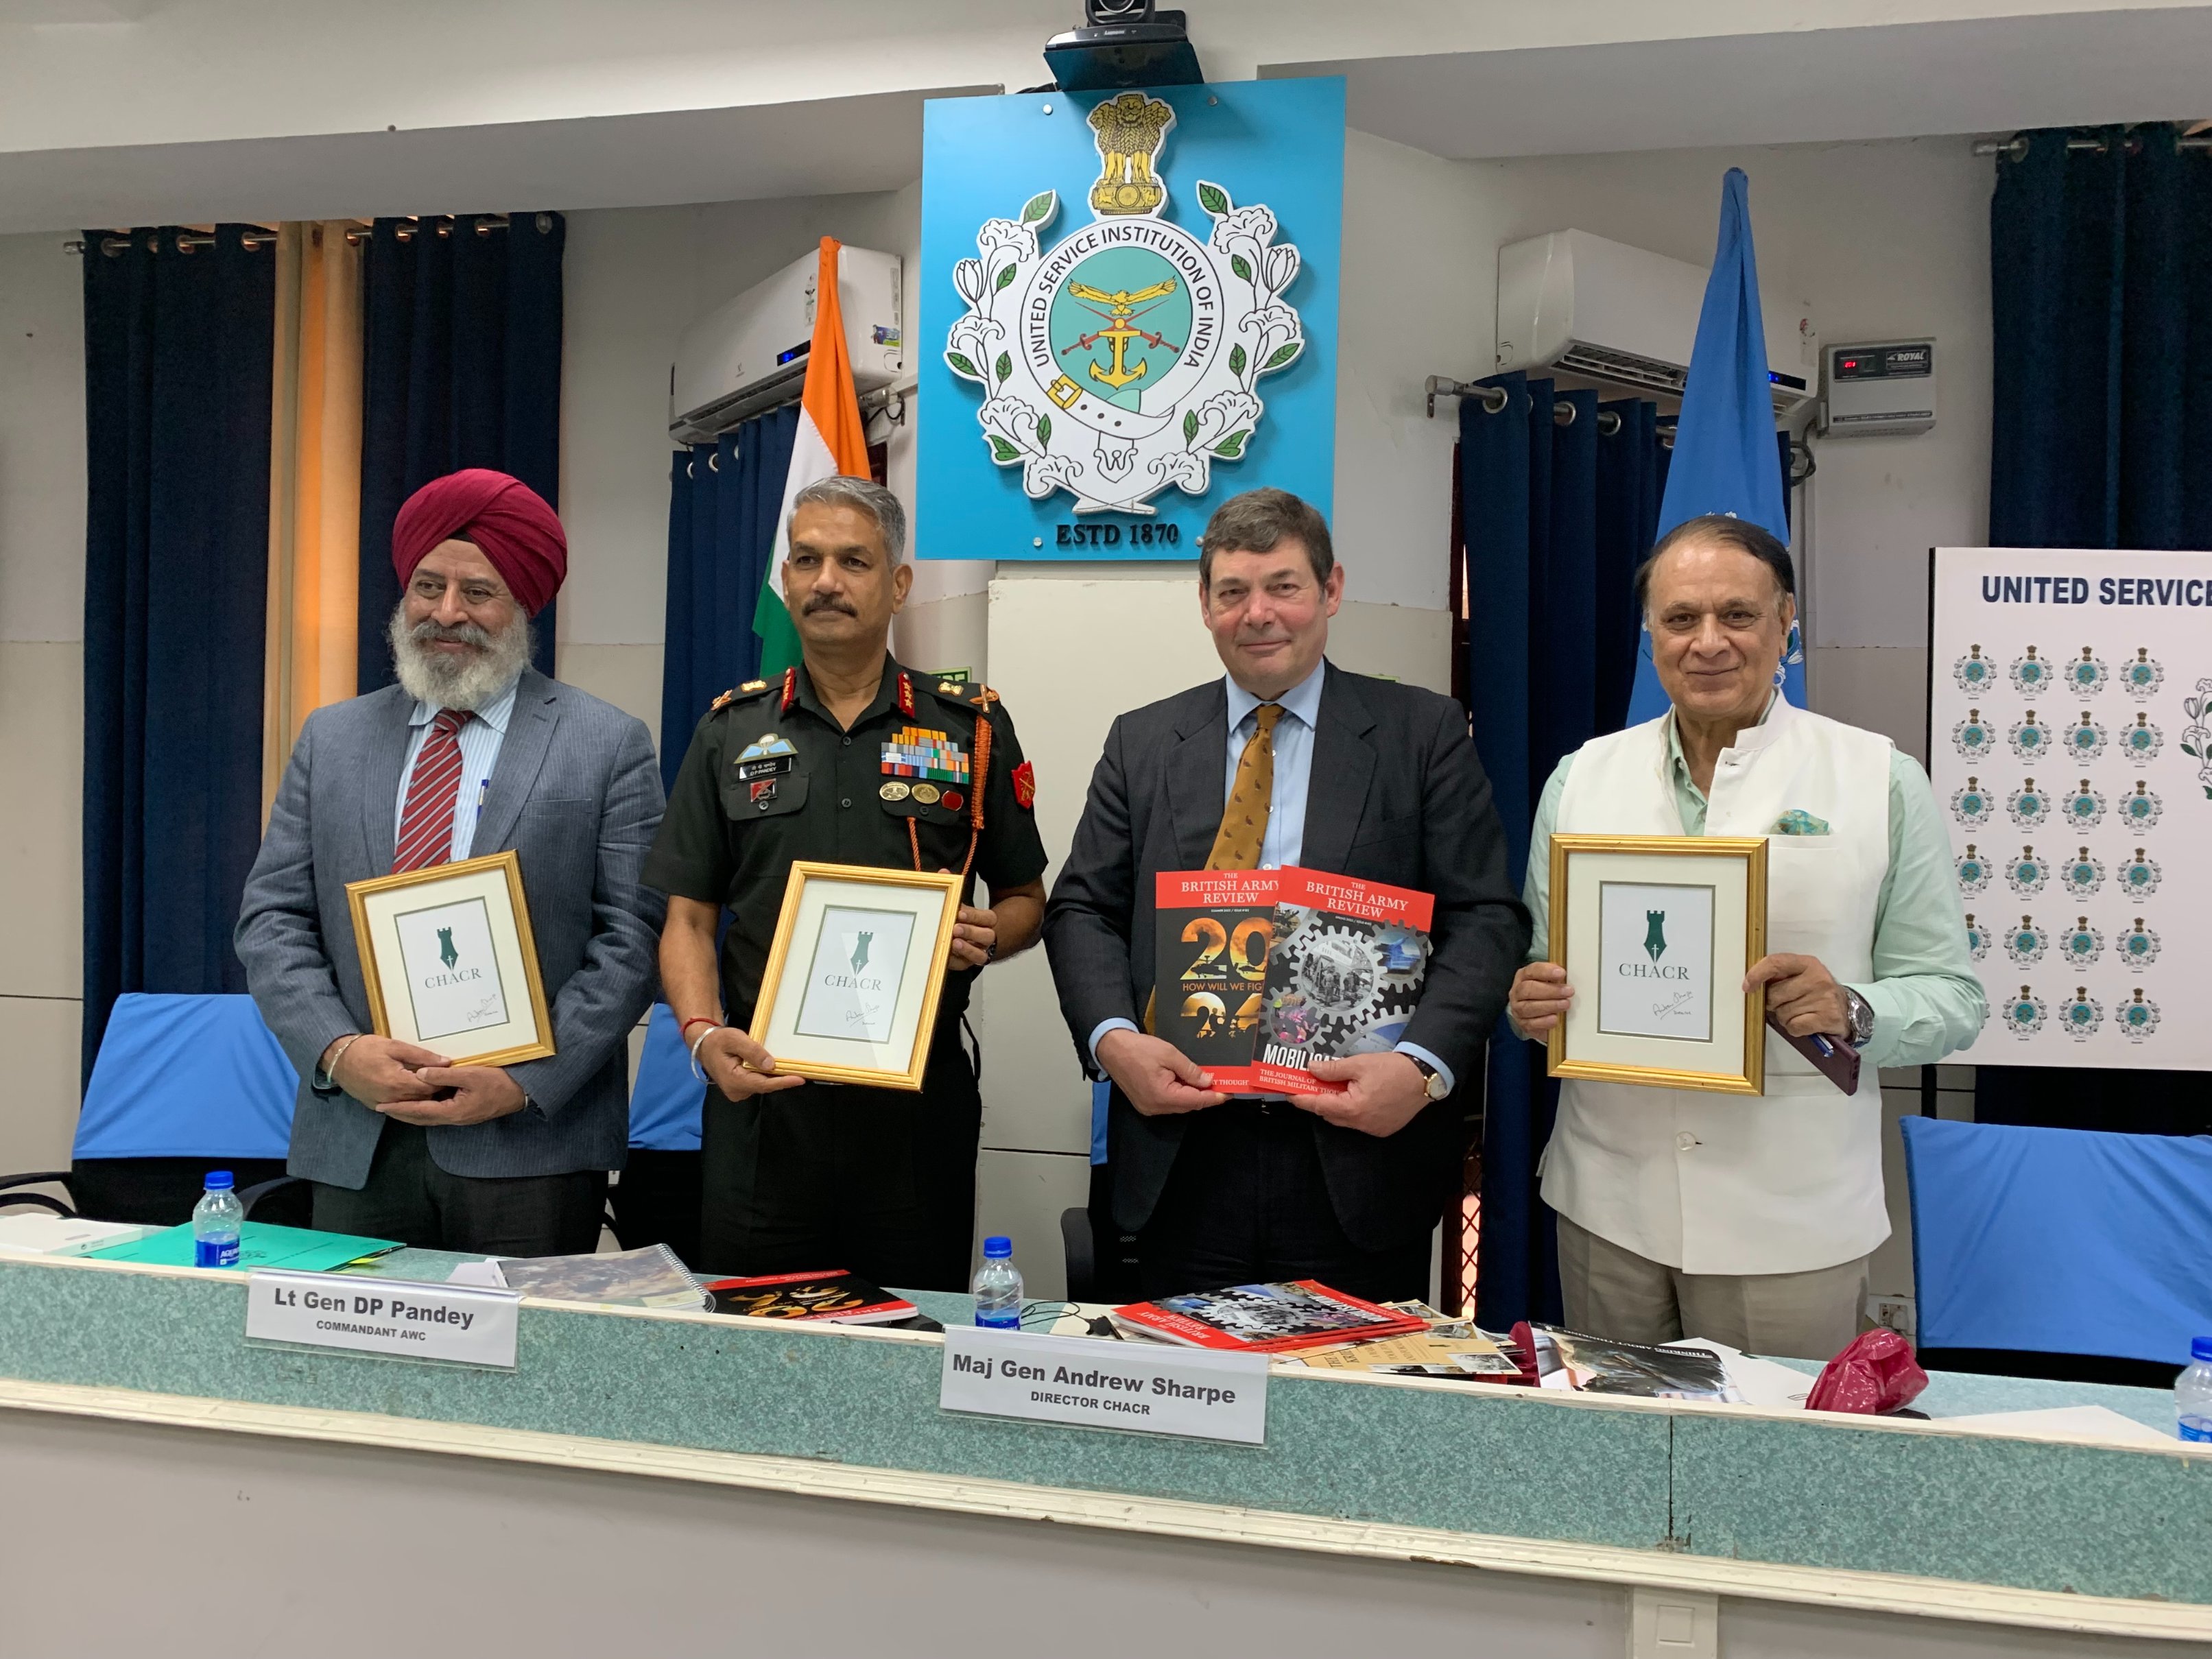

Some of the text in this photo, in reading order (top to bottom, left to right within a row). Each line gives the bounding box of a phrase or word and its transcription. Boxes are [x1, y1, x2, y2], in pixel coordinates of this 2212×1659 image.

[1030, 226, 1213, 368] UNITED SERVICE INSTITUTION OF INDIA
[1056, 523, 1178, 544] ESTD 1870
[1982, 575, 2089, 604] UNITED
[1181, 881, 1237, 892] BRITISH
[1306, 881, 1409, 911] BRITISH ARMY
[1351, 882, 1366, 890] THE
[1203, 893, 1259, 903] REVIEW
[1327, 898, 1384, 918] REVIEW
[425, 968, 481, 988] CHACR
[1619, 963, 1690, 980] CHACR
[824, 975, 881, 990] CHACR
[1182, 982, 1262, 991] HOW WILL WE FIG
[1259, 1075, 1286, 1085] BRITISH
[1287, 1081, 1318, 1092] MILITARY
[1260, 1069, 1274, 1077] THE
[1275, 1072, 1307, 1083] JOURNAL
[274, 1288, 475, 1330] Lt Gen DP Pandey
[316, 1320, 427, 1341] COMMANDANT AWC
[953, 1354, 1237, 1405] Maj Gen Andrew Sharpe
[1030, 1391, 1151, 1416] DIRECTOR CHACR
